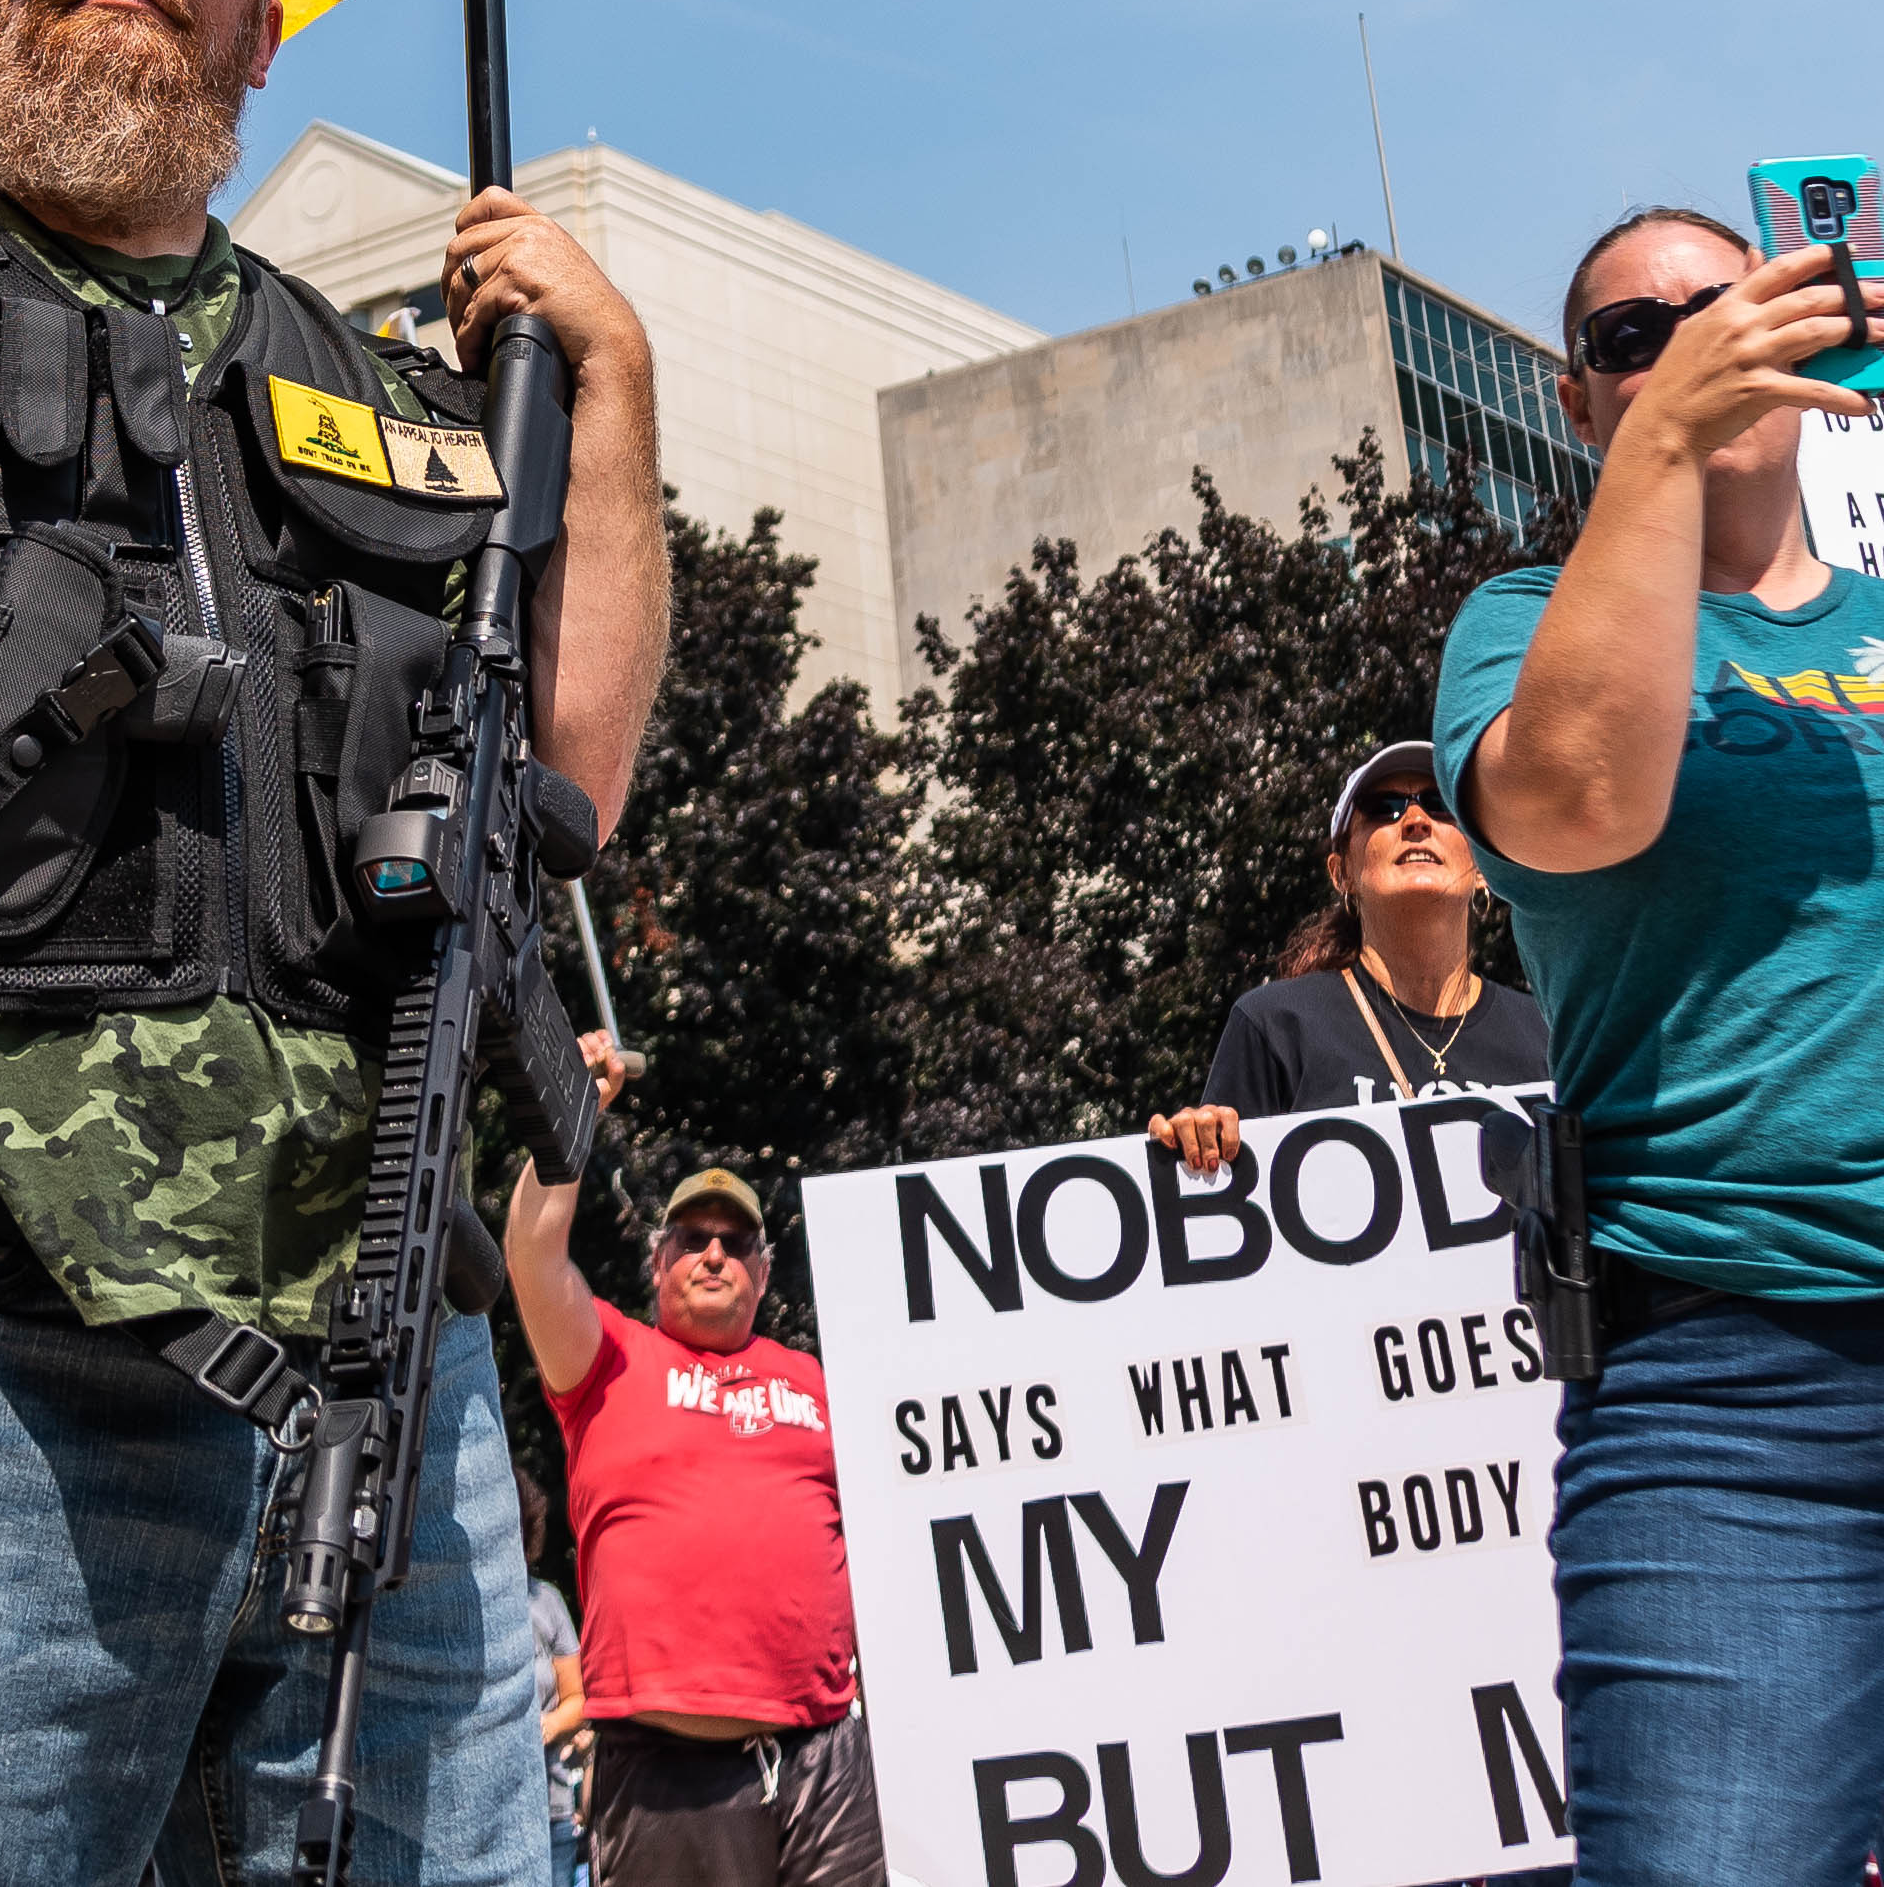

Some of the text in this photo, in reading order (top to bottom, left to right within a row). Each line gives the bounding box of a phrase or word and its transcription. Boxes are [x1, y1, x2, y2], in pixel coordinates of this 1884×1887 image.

[383, 418, 483, 448] AN APPEAL TO HEAVEN
[1846, 491, 1867, 529] A
[894, 1093, 1550, 1324] NOBOD
[666, 1366, 720, 1413] WE
[723, 1385, 770, 1419] ARE
[895, 1306, 1544, 1476] SAYS WHAT GOES
[930, 1459, 1522, 1677] MY BODY
[972, 1712, 1344, 1887] BUT
